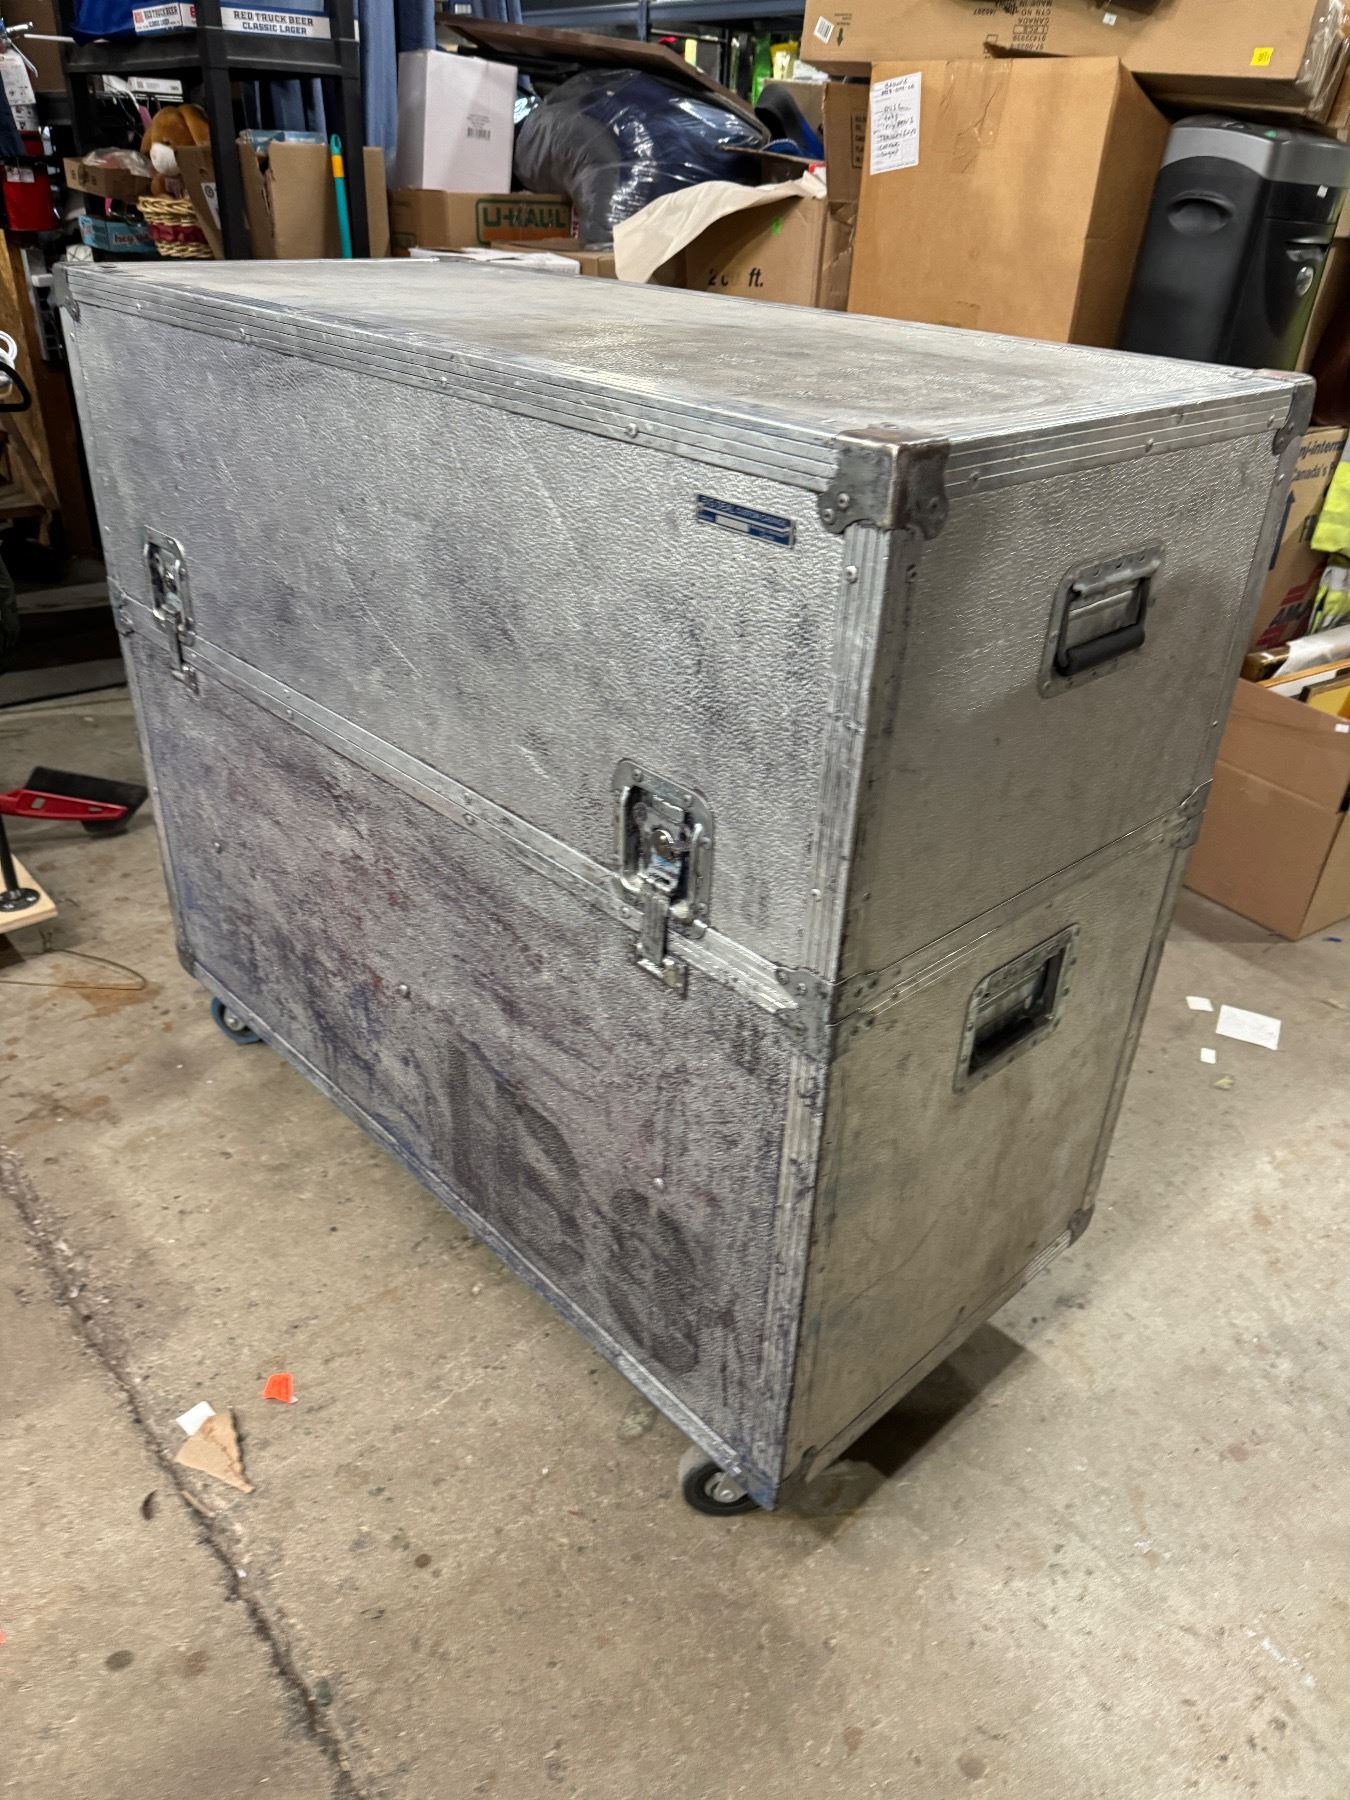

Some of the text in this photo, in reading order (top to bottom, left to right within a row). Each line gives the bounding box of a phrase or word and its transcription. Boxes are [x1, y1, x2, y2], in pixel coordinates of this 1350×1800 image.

[233, 10, 314, 26] RED TRUCK BEER
[242, 22, 307, 35] CLASSIC LAGER
[483, 206, 566, 229] U-HAUL
[748, 267, 764, 287] ft.
